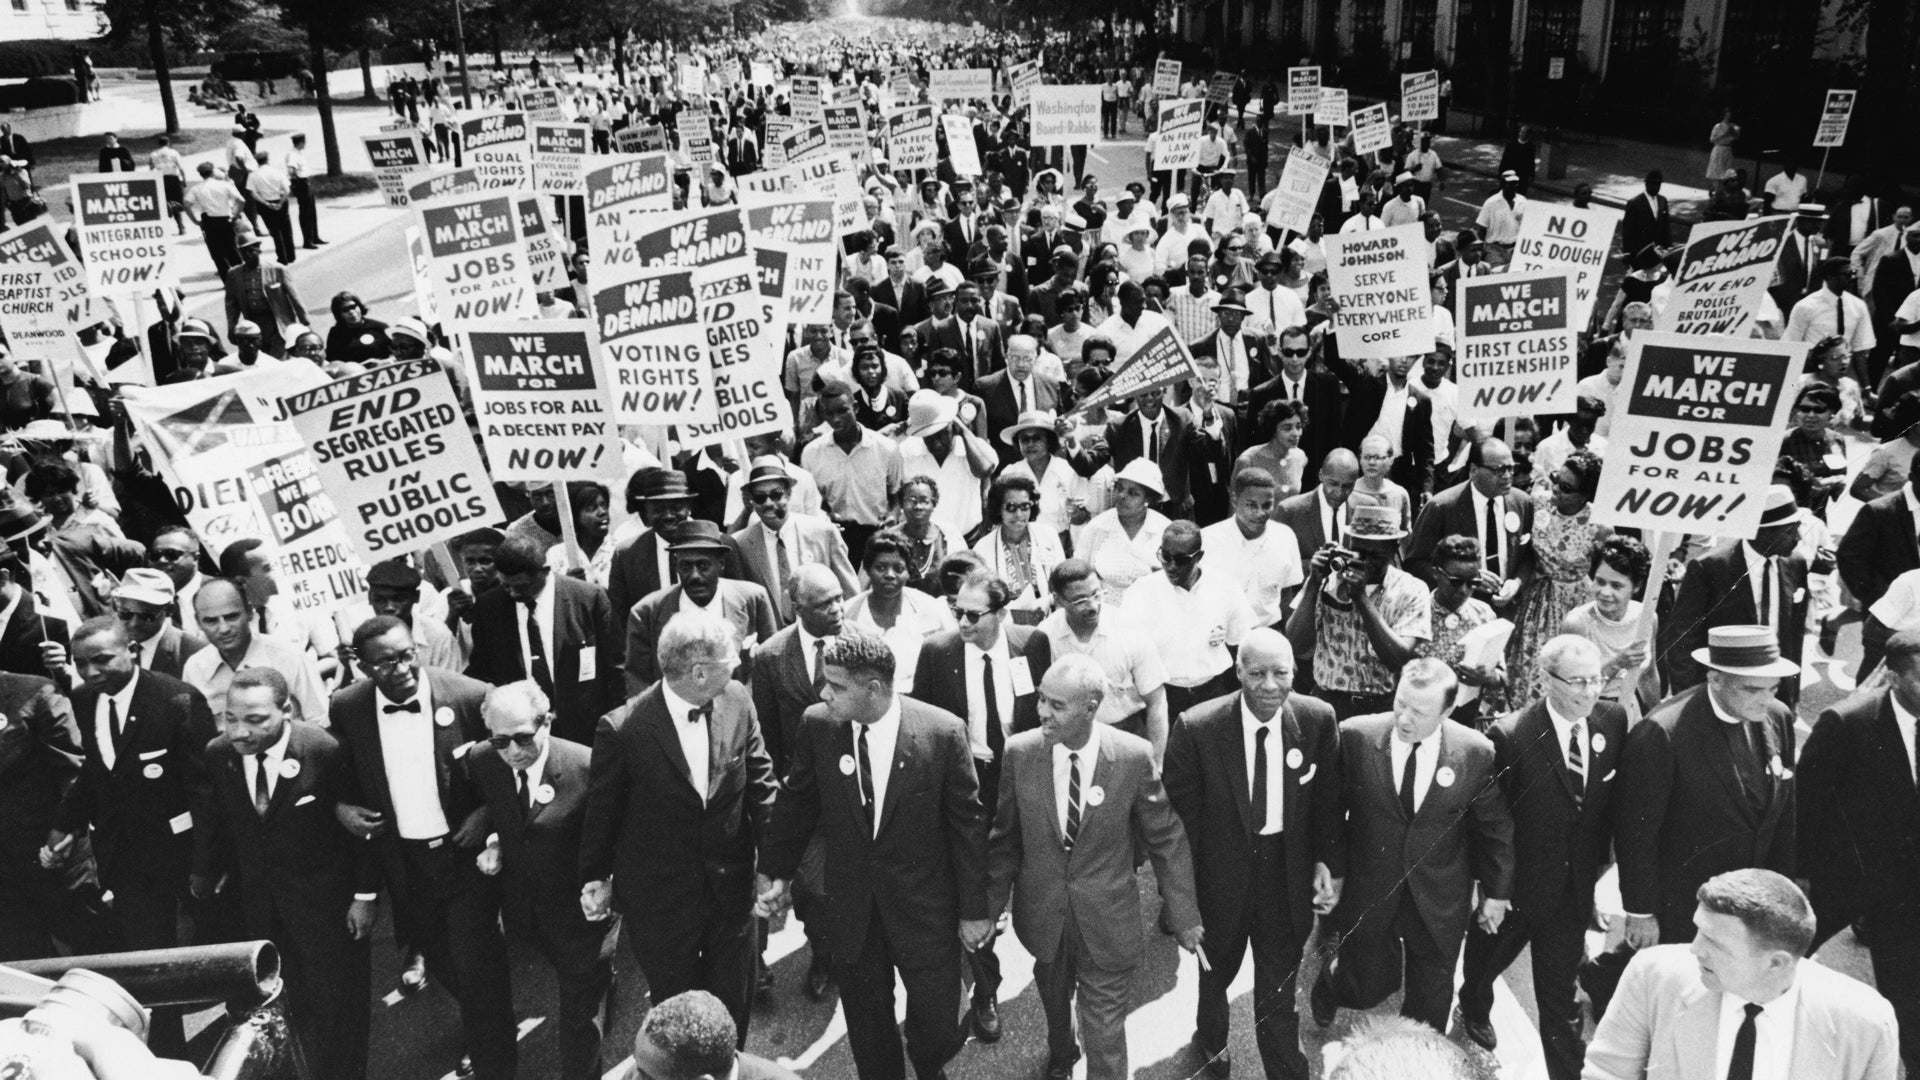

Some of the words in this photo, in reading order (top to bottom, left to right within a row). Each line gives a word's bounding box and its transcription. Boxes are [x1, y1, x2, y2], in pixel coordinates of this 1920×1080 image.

[481, 116, 505, 131] WE
[553, 129, 569, 138] WE
[380, 140, 396, 149] WE
[466, 125, 524, 148] DEMAND
[540, 136, 583, 148] MARCH
[1162, 134, 1174, 142] AN
[373, 148, 413, 160] MARCH
[622, 141, 650, 153] JOBS
[1169, 143, 1191, 152] LAW
[475, 152, 522, 163] EQUAL
[897, 153, 932, 165] NOW!
[1160, 152, 1196, 164] NOW!
[612, 161, 641, 183] WE
[802, 160, 846, 181] I.U.E.
[104, 183, 129, 196] WE
[542, 180, 582, 190] NOW!
[592, 172, 666, 208] DEMAND
[86, 196, 154, 214] MARCH
[391, 195, 407, 206] NO
[108, 213, 135, 222] FOR
[454, 204, 483, 221] WE
[596, 212, 621, 227] AN
[770, 204, 807, 226] WE
[85, 226, 164, 244] INTEGRATED
[435, 214, 509, 245] MARCH
[670, 219, 708, 249] WE
[750, 218, 832, 243] DEMAND
[1547, 215, 1588, 238] NO
[1, 238, 27, 256] WE
[461, 238, 491, 251] FOR
[649, 231, 744, 268] DEMAND
[1342, 237, 1398, 255] HOWARD
[1716, 227, 1758, 253] WE
[90, 245, 166, 263] SCHOOLS
[604, 248, 634, 265] NO
[1340, 249, 1405, 267] JOHNSON
[1519, 238, 1544, 257] U.S.
[1547, 243, 1604, 267] DOUGH
[1683, 238, 1777, 280] DEMAND
[101, 261, 165, 285] NOW!
[445, 253, 515, 283] JOBS
[1, 272, 42, 285] FIRST
[450, 284, 482, 296] FOR
[491, 276, 516, 289] ALL
[702, 276, 747, 300] AYS:
[1354, 270, 1397, 287] SERVE
[1684, 282, 1716, 294] AN
[1719, 276, 1756, 292] END
[0, 286, 52, 300] BAPTIST
[624, 280, 660, 307] WE
[1339, 287, 1419, 308] EVERYONE
[1500, 283, 1532, 301] WE
[1694, 295, 1737, 309] POLICE
[2, 301, 54, 315] CHURCH
[455, 287, 524, 319] NOW!
[1472, 297, 1560, 323] MARCH
[604, 296, 694, 338] DEMAND
[1337, 306, 1427, 326] EVERYWHERE
[1674, 312, 1749, 335] NOW!
[1677, 306, 1742, 322] BRUTALITY
[12, 329, 65, 339] DEANWOOD
[706, 318, 760, 346] GATED
[1362, 328, 1401, 343] CORE
[1499, 320, 1534, 332] FOR
[509, 336, 547, 353] WE
[609, 345, 700, 363] VOTING
[1465, 341, 1512, 359] FIRST
[1517, 336, 1568, 355] CLASS
[483, 355, 584, 375] MARCH
[709, 344, 750, 369] LES
[1462, 355, 1570, 378] CITIZENSHIP
[1693, 354, 1737, 377] WE
[618, 368, 699, 386] RIGHTS
[1143, 359, 1168, 379] JOBS
[295, 379, 350, 412] UAW
[357, 358, 433, 394] SAYS:
[517, 378, 557, 388] FOR
[1473, 378, 1562, 408] NOW!
[1642, 374, 1771, 407] MARCH
[621, 388, 702, 413] NOW!
[715, 381, 769, 408] BLIC
[329, 387, 421, 432] END
[484, 401, 526, 415] JOBS
[531, 400, 566, 414] FOR
[571, 400, 603, 413] ALL
[1677, 404, 1726, 420] FOR
[488, 424, 501, 437] A
[502, 423, 567, 437] DECENT
[572, 421, 606, 435] PAY
[687, 402, 778, 438] SCHOOLS
[312, 402, 456, 464] SEGREGATED
[343, 433, 446, 481] RULES
[508, 443, 605, 470] NOW!
[1629, 430, 1753, 466] JOBS
[1628, 464, 1679, 480] FOR
[1694, 470, 1740, 485] ALL
[278, 484, 301, 503] WE
[357, 472, 472, 525] PUBLIC
[1615, 487, 1746, 522] NOW!
[364, 495, 487, 551] SCHOOLS
[293, 579, 309, 594] WE
[328, 566, 368, 600] LIVE
[292, 590, 327, 611] MUST
